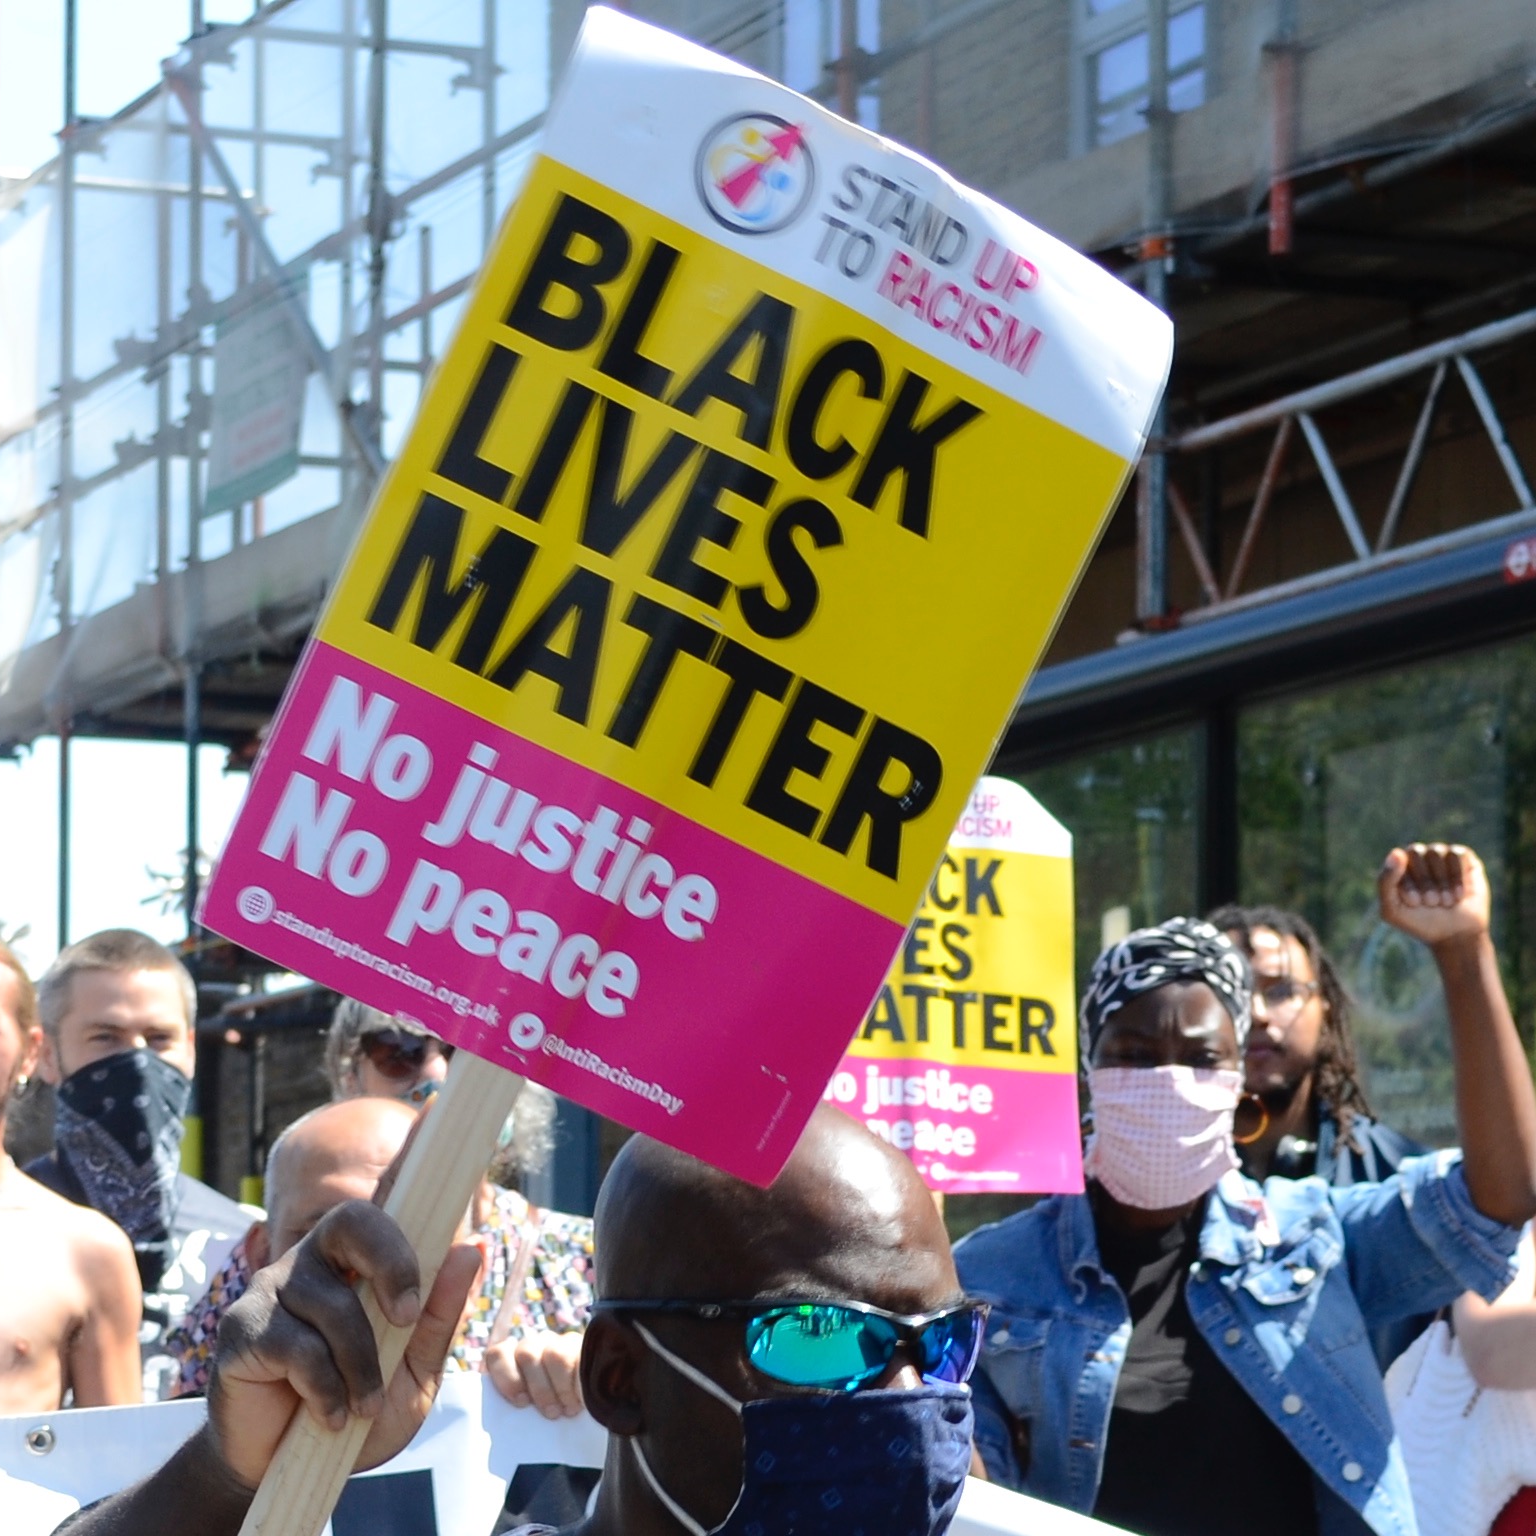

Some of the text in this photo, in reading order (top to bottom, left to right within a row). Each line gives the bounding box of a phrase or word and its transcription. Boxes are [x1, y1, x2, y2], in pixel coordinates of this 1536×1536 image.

[814, 213, 1044, 378] TO RACISM
[830, 165, 1040, 302] STAND UP
[501, 191, 985, 538] BLACK
[432, 342, 843, 641] LIVES
[366, 490, 944, 882] MATTER
[259, 771, 640, 1018] No peace
[303, 674, 719, 942] No justice
[272, 908, 685, 1116] standuptoracism.org.uk @AntiRacismDay
[857, 982, 1057, 1057] ATTER
[862, 1064, 994, 1115] justice
